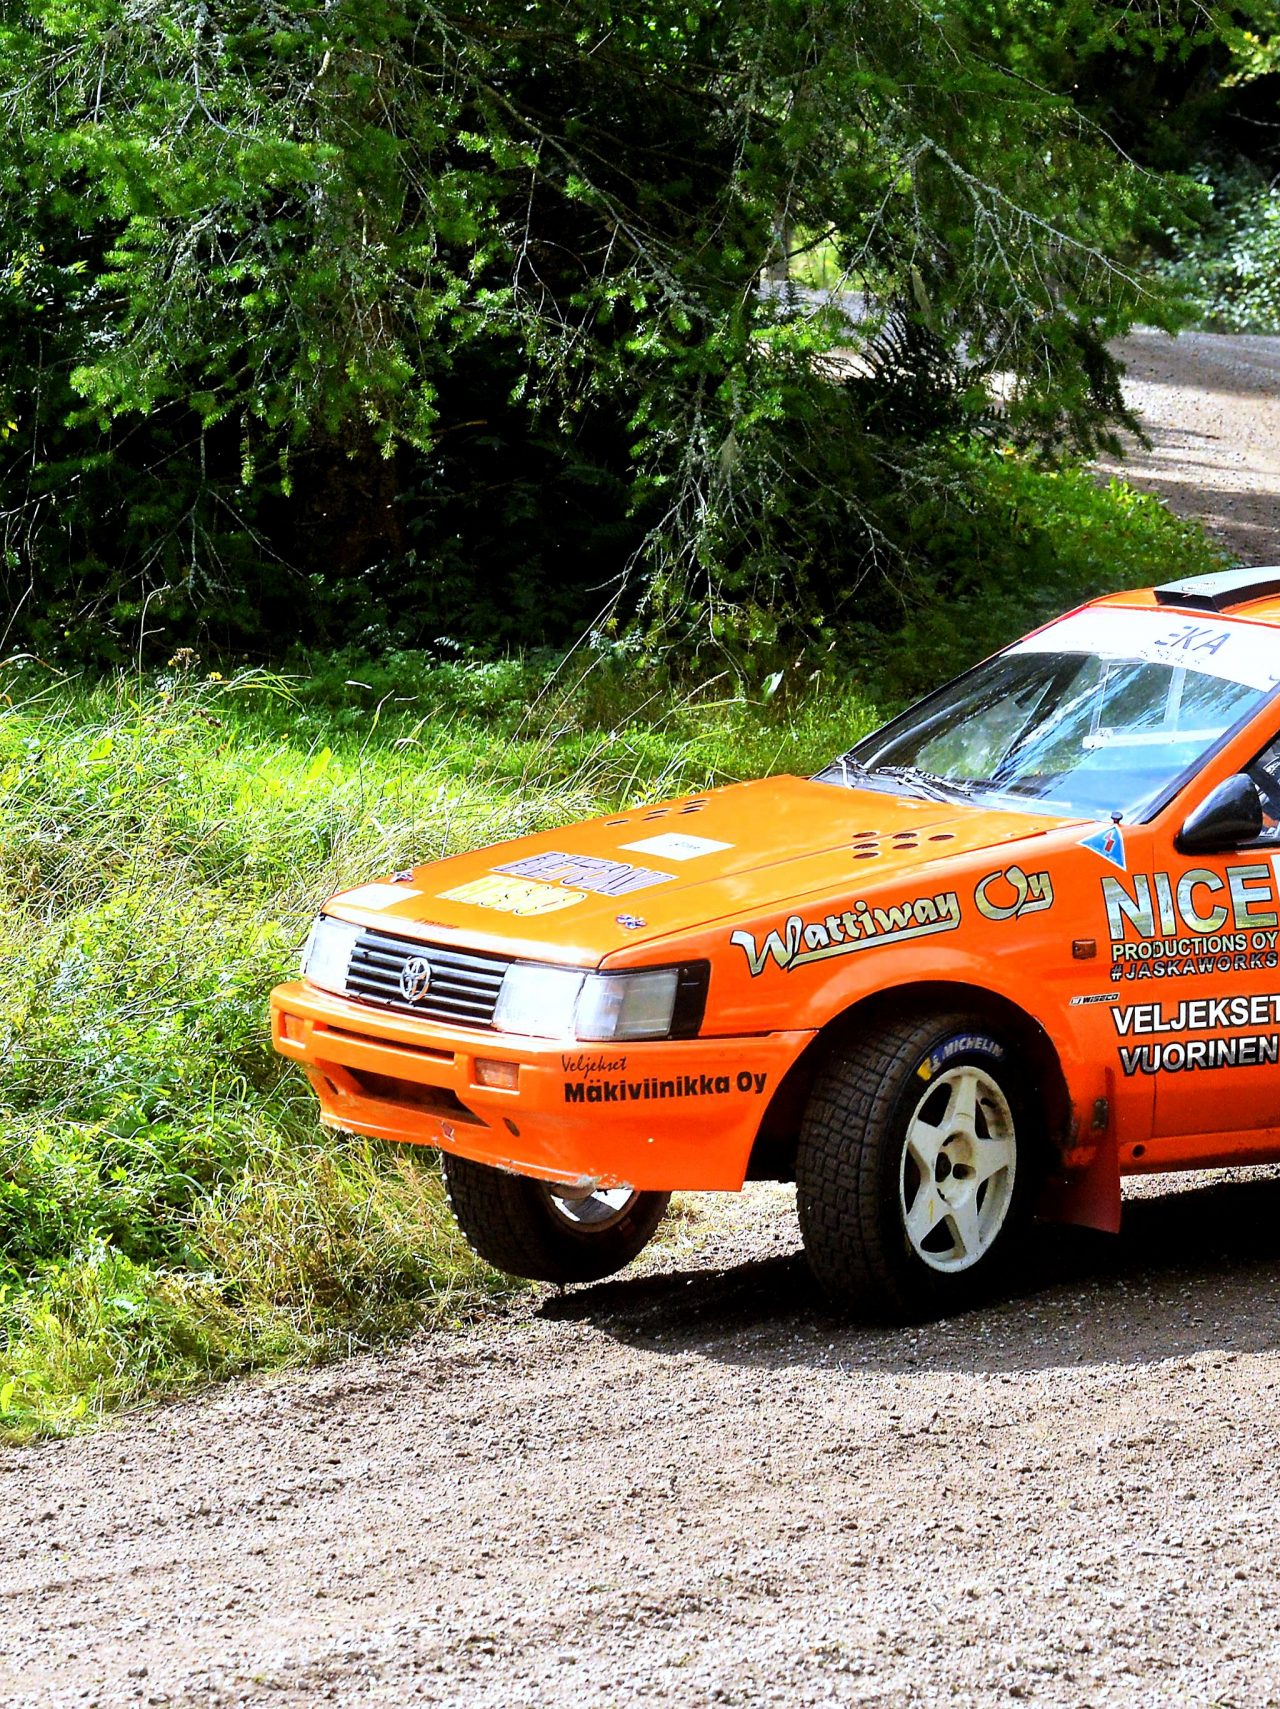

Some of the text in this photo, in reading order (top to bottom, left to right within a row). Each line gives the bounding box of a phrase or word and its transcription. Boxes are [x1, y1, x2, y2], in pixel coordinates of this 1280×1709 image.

[1101, 864, 1279, 940] NICE
[730, 865, 1054, 977] Wattiway Oy
[1111, 930, 1280, 962] PRODUCTIONS OY
[1110, 951, 1279, 982] #JASKAWORKS
[943, 1036, 1004, 1059] MICHELIN
[1117, 1034, 1280, 1077] VUORINEN
[561, 1055, 627, 1078] Veljekset
[564, 1071, 768, 1103] Mäkiviinikka Oy
